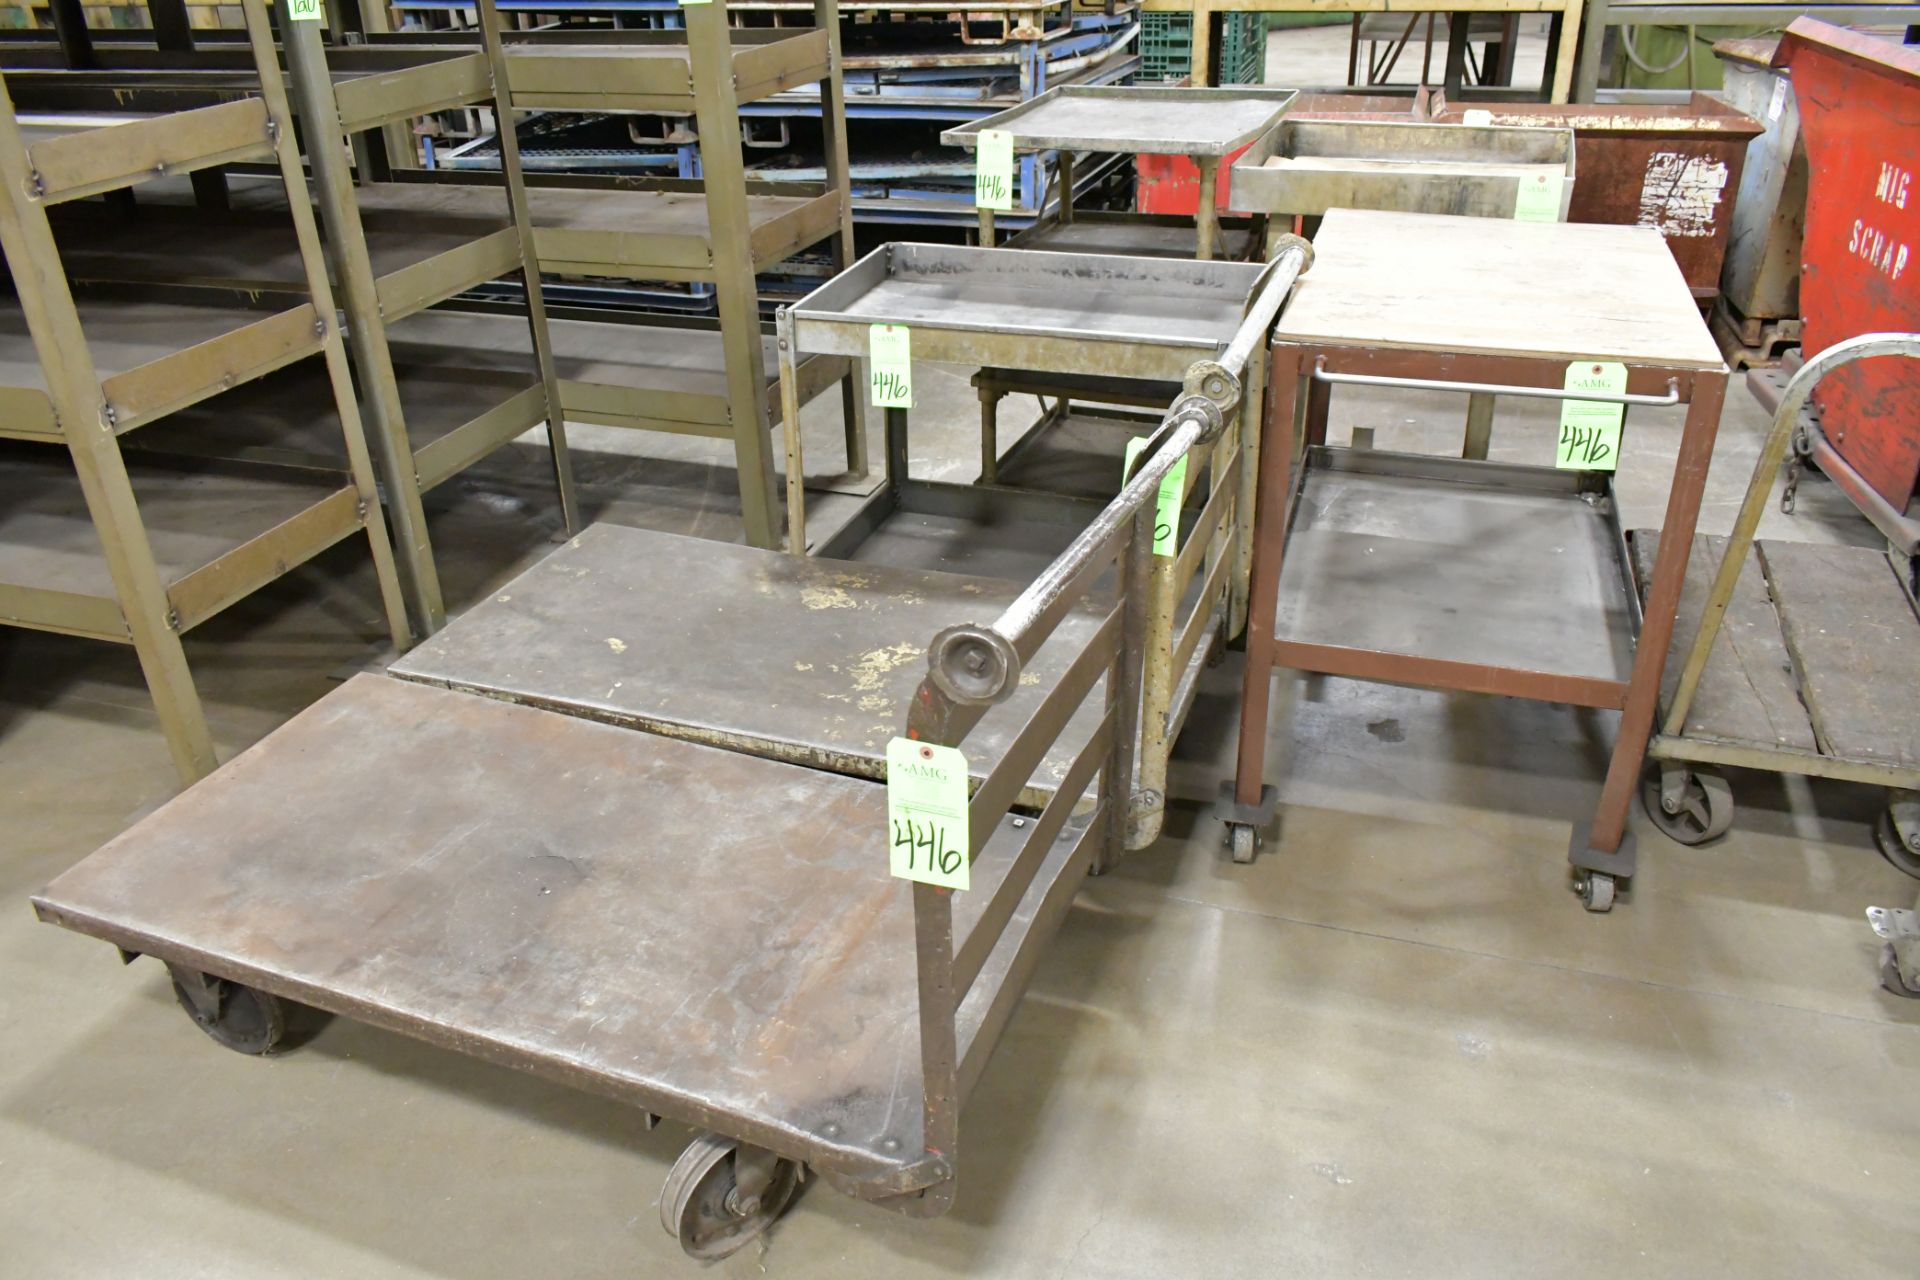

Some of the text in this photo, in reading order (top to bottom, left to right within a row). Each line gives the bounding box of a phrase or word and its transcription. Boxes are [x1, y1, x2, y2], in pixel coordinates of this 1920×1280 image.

[978, 174, 1006, 201] 446
[1848, 219, 1908, 280] SCRAP
[872, 371, 908, 400] 446
[1560, 425, 1610, 464] 446
[894, 819, 961, 874] 446
